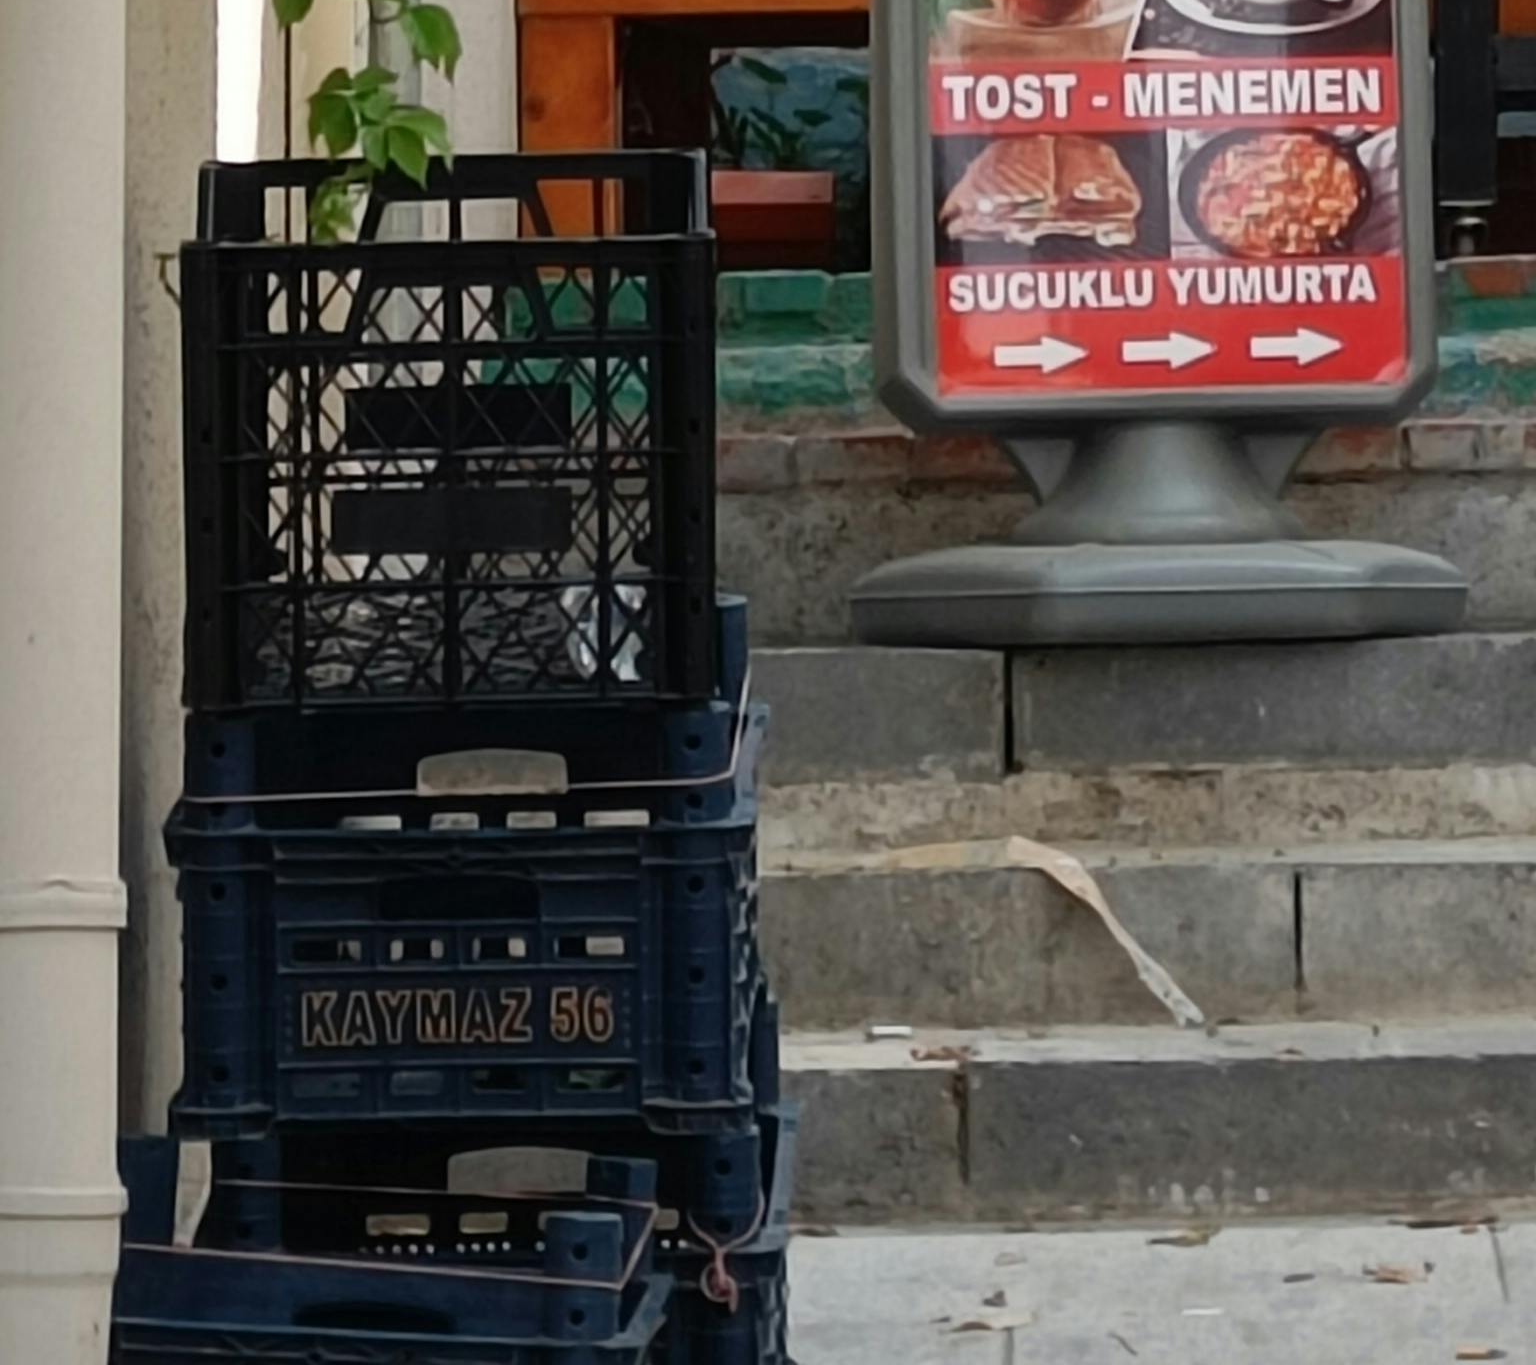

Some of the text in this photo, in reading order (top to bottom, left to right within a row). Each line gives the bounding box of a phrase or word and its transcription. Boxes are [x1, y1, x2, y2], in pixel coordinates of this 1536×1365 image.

[942, 72, 1079, 121] TOST
[1122, 67, 1382, 118] MENEMEN
[948, 263, 1377, 313] SUCUKLU YUMURTA
[301, 985, 614, 1047] KAYMAZ 56
